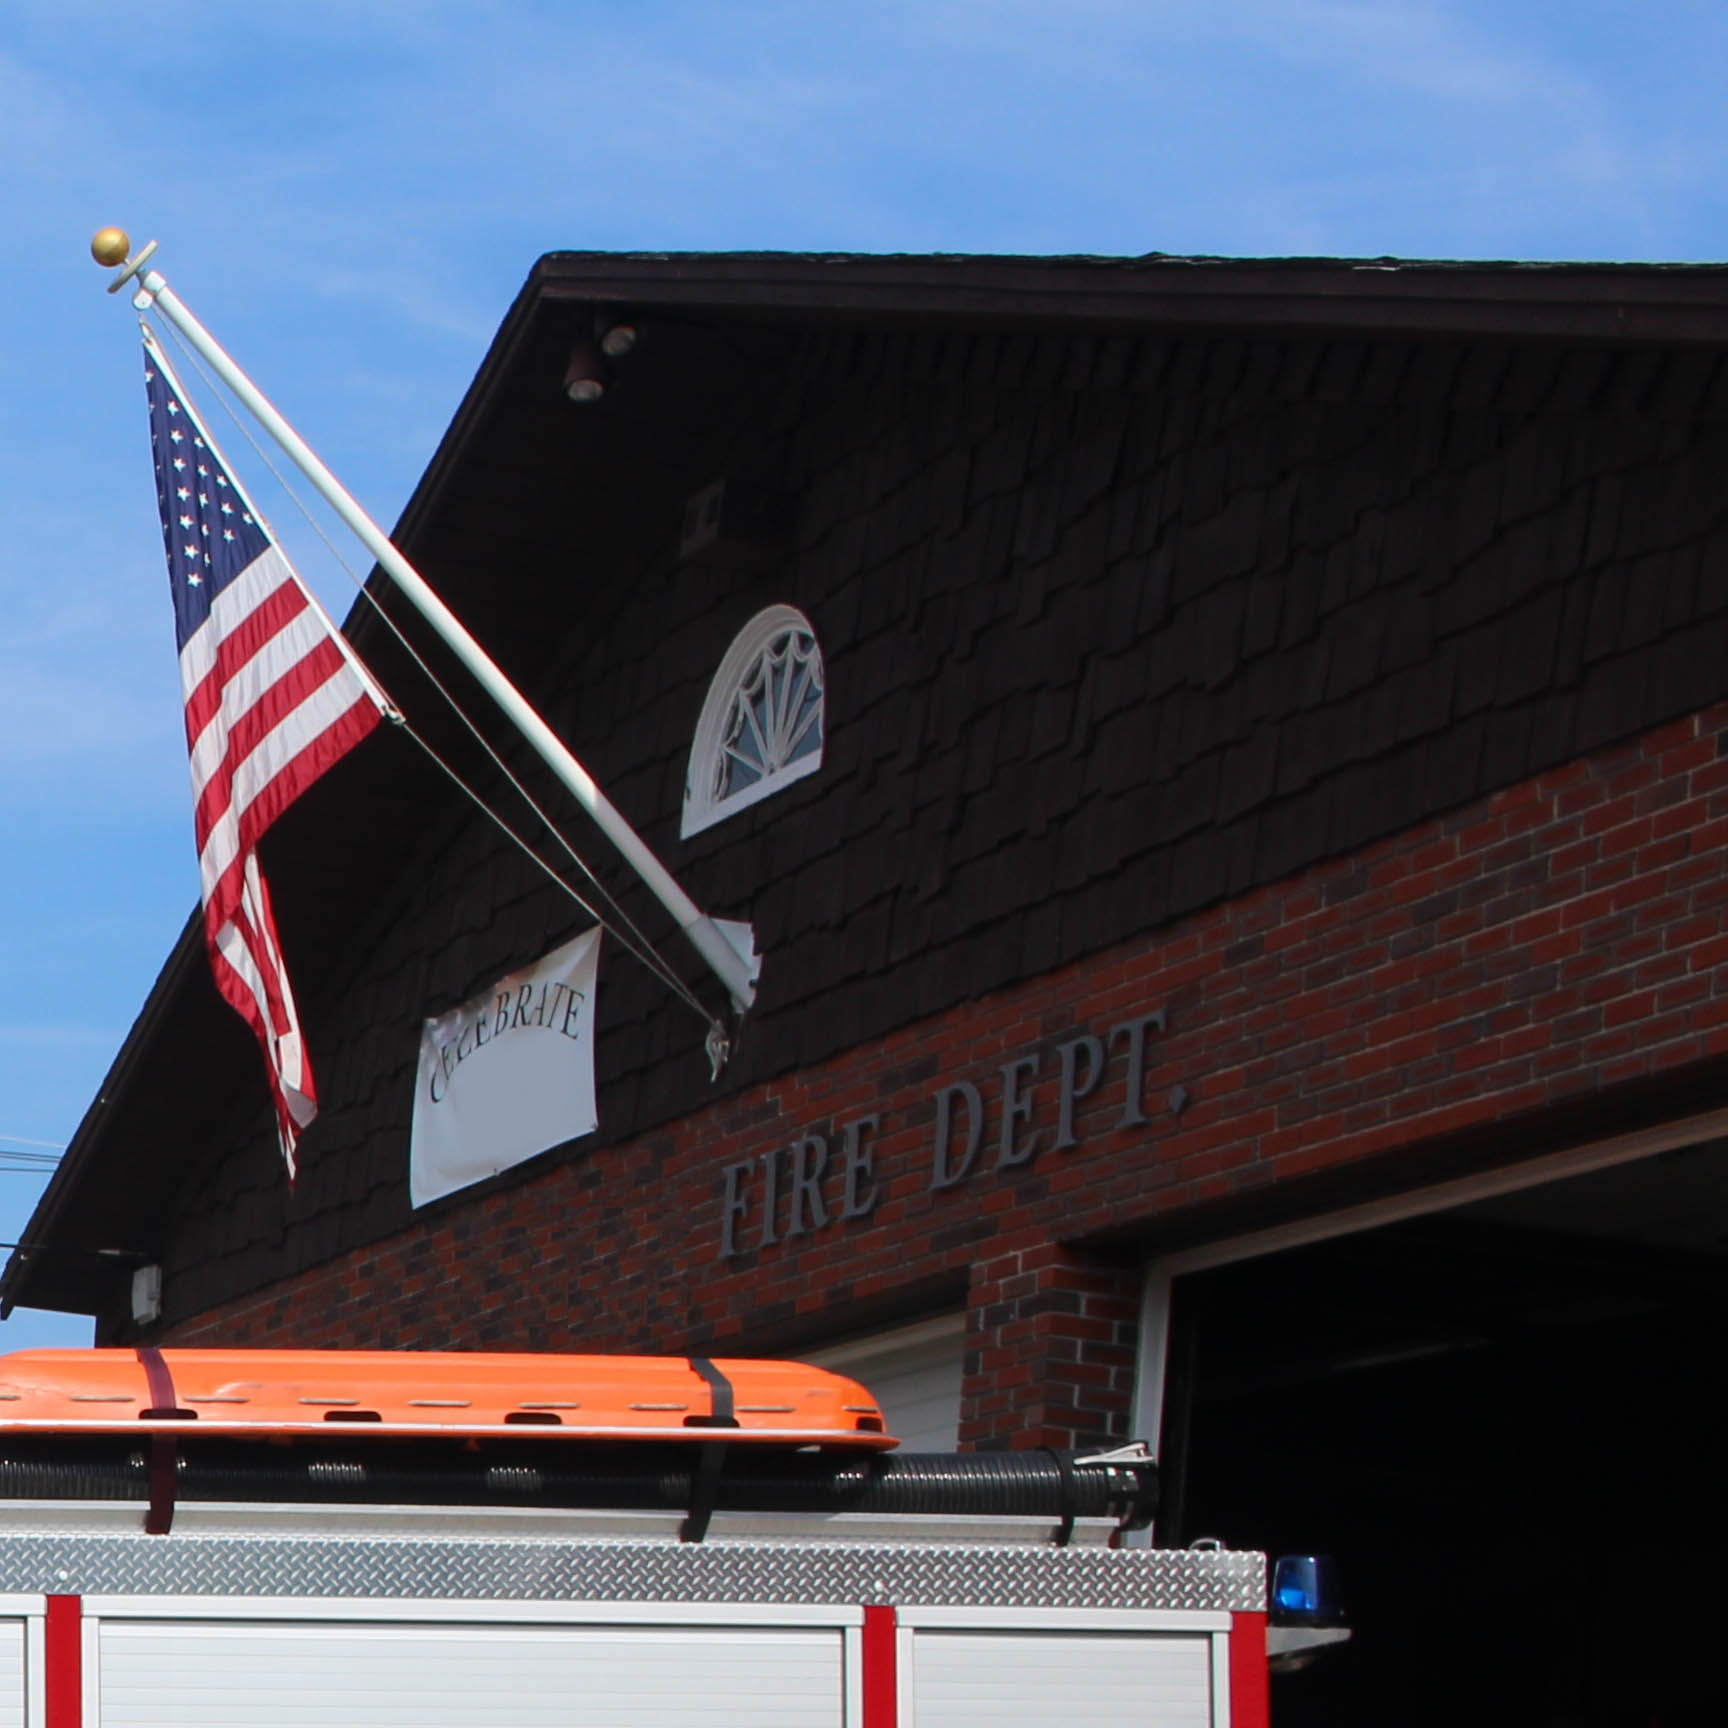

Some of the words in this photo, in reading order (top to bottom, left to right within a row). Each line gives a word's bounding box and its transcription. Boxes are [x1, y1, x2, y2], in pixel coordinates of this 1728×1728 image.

[430, 983, 584, 1103] CELEBRATE
[718, 1113, 880, 1260] FIRE
[929, 1009, 1187, 1192] DEPT.
